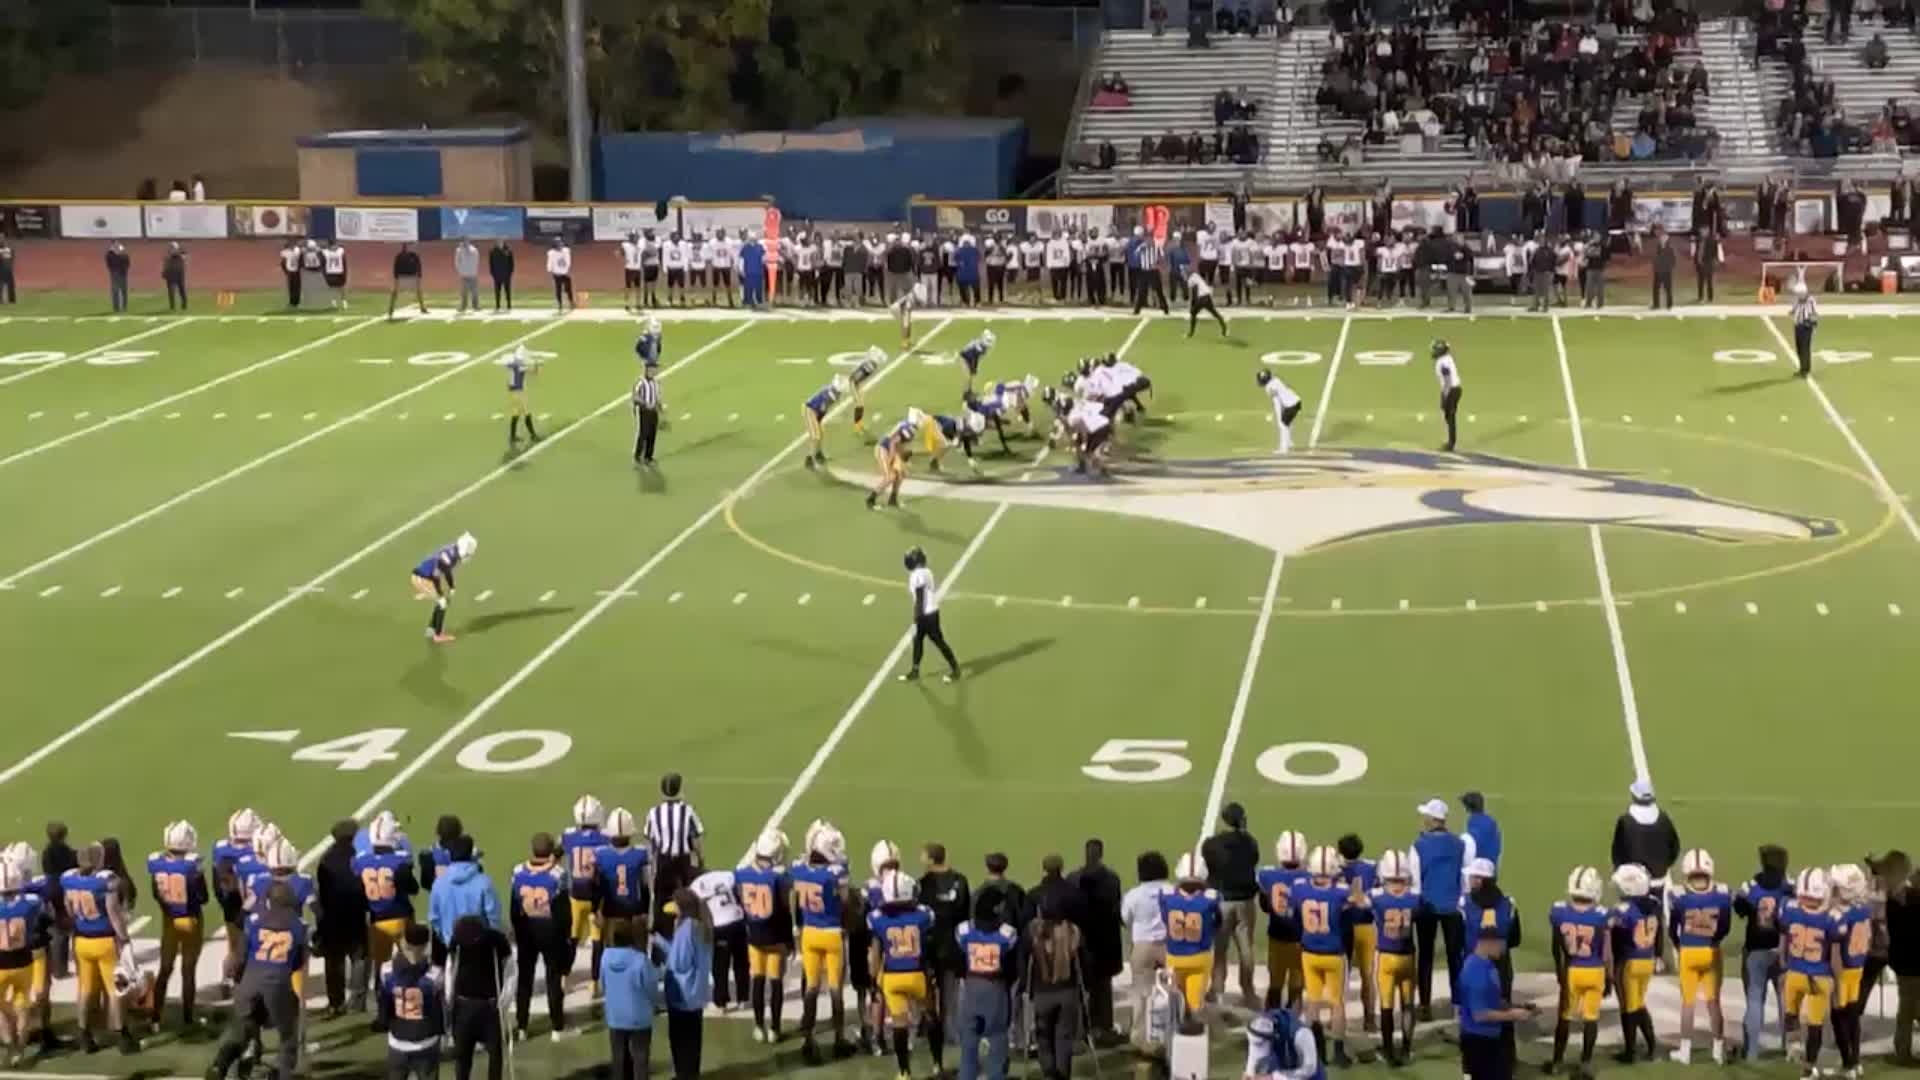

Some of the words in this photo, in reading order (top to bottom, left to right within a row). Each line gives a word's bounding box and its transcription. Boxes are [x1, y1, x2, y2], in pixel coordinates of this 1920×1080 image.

[985, 208, 1010, 223] GO
[1081, 739, 1369, 787] 50
[616, 863, 630, 897] 1
[793, 879, 825, 914] 75
[742, 883, 773, 920] 50
[1301, 899, 1341, 934] 61
[1789, 923, 1826, 962] 35
